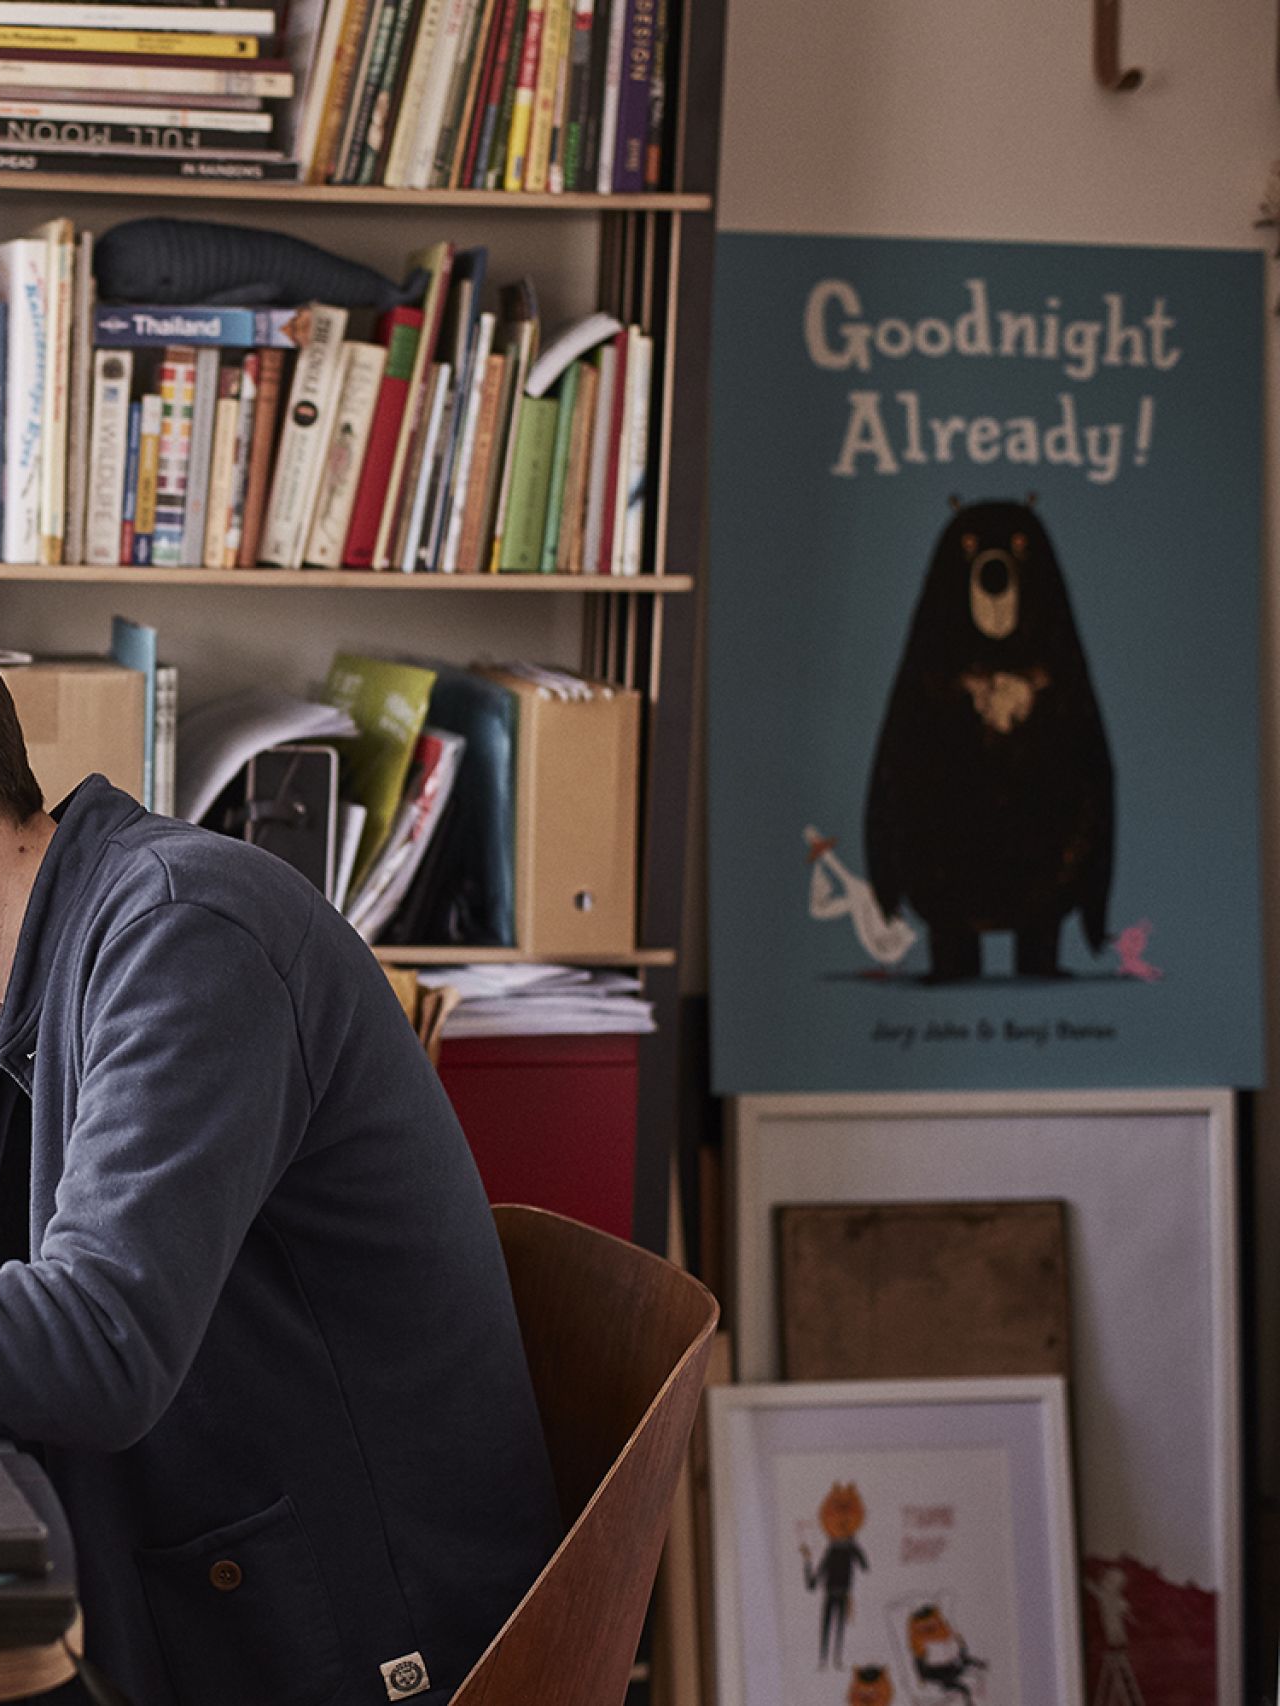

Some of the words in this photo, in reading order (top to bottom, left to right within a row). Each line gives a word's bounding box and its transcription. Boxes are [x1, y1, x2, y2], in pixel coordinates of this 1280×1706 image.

[6, 120, 112, 144] MOON
[127, 127, 201, 150] FULL
[132, 313, 222, 339] Thailand
[803, 278, 1183, 380] Goodnight
[830, 390, 1155, 485] Already!
